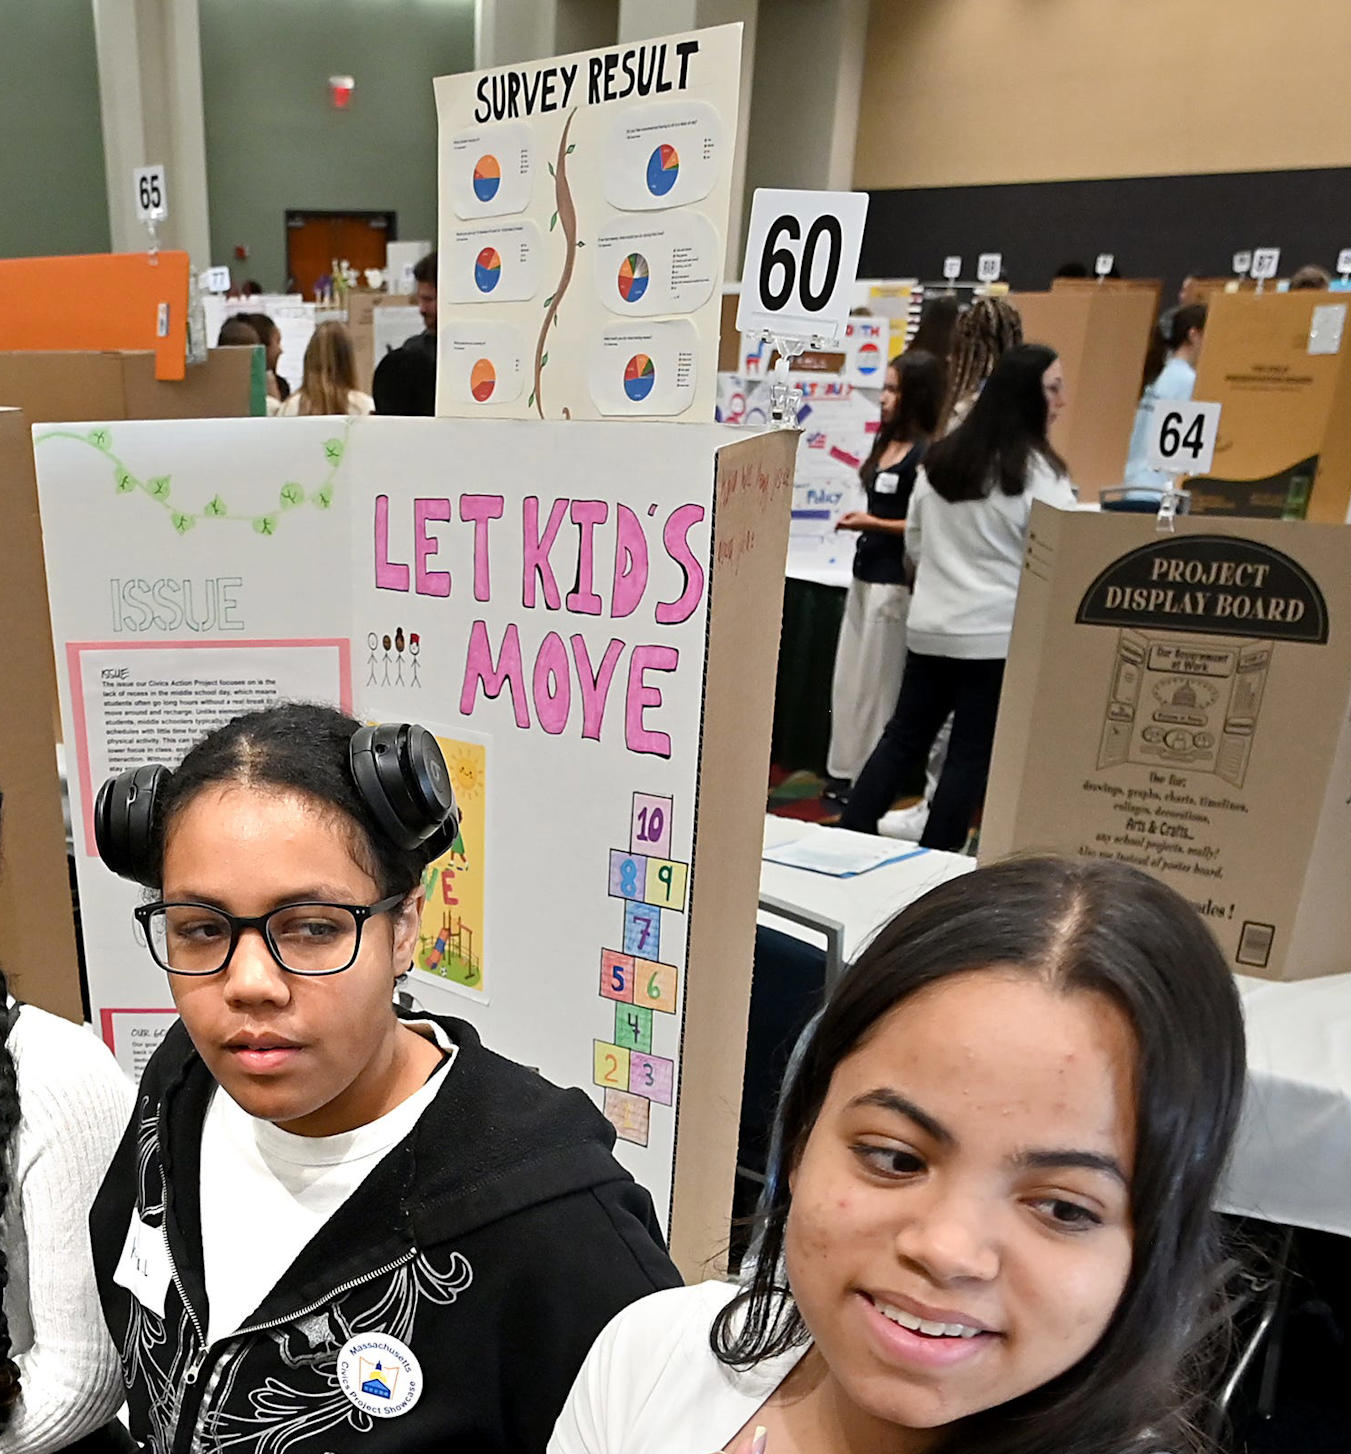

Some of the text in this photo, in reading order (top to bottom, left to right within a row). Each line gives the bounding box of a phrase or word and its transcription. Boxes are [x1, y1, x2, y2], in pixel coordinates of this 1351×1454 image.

[474, 40, 700, 124] SURVEY RESULT
[139, 174, 161, 210] 65
[759, 214, 843, 312] 60
[1159, 411, 1206, 459] 64
[374, 494, 705, 625] LET KID'S
[1151, 557, 1271, 588] PROJECT
[110, 576, 245, 633] ISSUE
[1104, 585, 1306, 623] DISPLAY BOARD
[101, 668, 130, 680] ISSUE
[148, 680, 169, 688] Civics
[194, 679, 218, 688] Project
[459, 620, 679, 759] MOVE
[163, 700, 178, 708] long
[161, 718, 194, 726] schoolers
[107, 737, 134, 746] physical
[1127, 787, 1162, 801] graphs,
[636, 806, 665, 844] 10
[1125, 817, 1147, 833] Arts
[1147, 820, 1158, 834] &
[619, 857, 638, 898] 8
[658, 864, 673, 902] 9
[632, 916, 652, 951] 7
[610, 965, 625, 992] 5
[646, 970, 661, 1001] 6
[131, 1028, 150, 1038] OUR
[627, 1012, 641, 1044] 4
[604, 1053, 619, 1083] 2
[642, 1062, 655, 1087] 3
[622, 1102, 633, 1129] 1
[349, 1343, 412, 1374] Massachusetts
[341, 1361, 416, 1415] Civics Project Showcase
